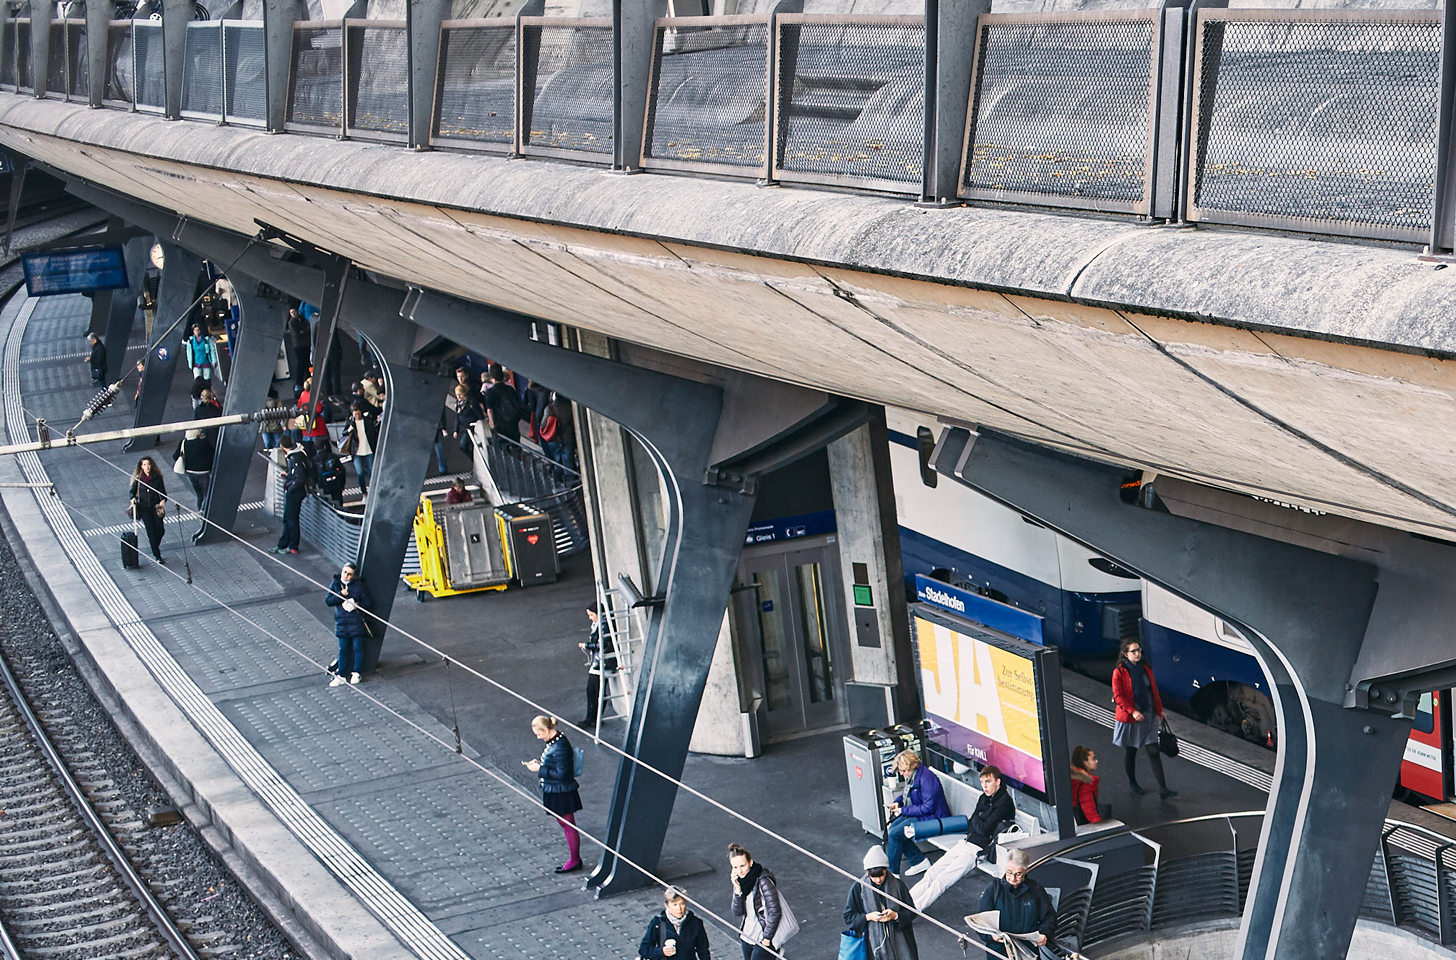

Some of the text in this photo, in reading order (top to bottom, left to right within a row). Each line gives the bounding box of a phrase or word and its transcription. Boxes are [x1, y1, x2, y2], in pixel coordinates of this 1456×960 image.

[925, 586, 966, 613] Stadelhofen
[921, 622, 1010, 744] JA
[1001, 664, 1013, 678] Zur
